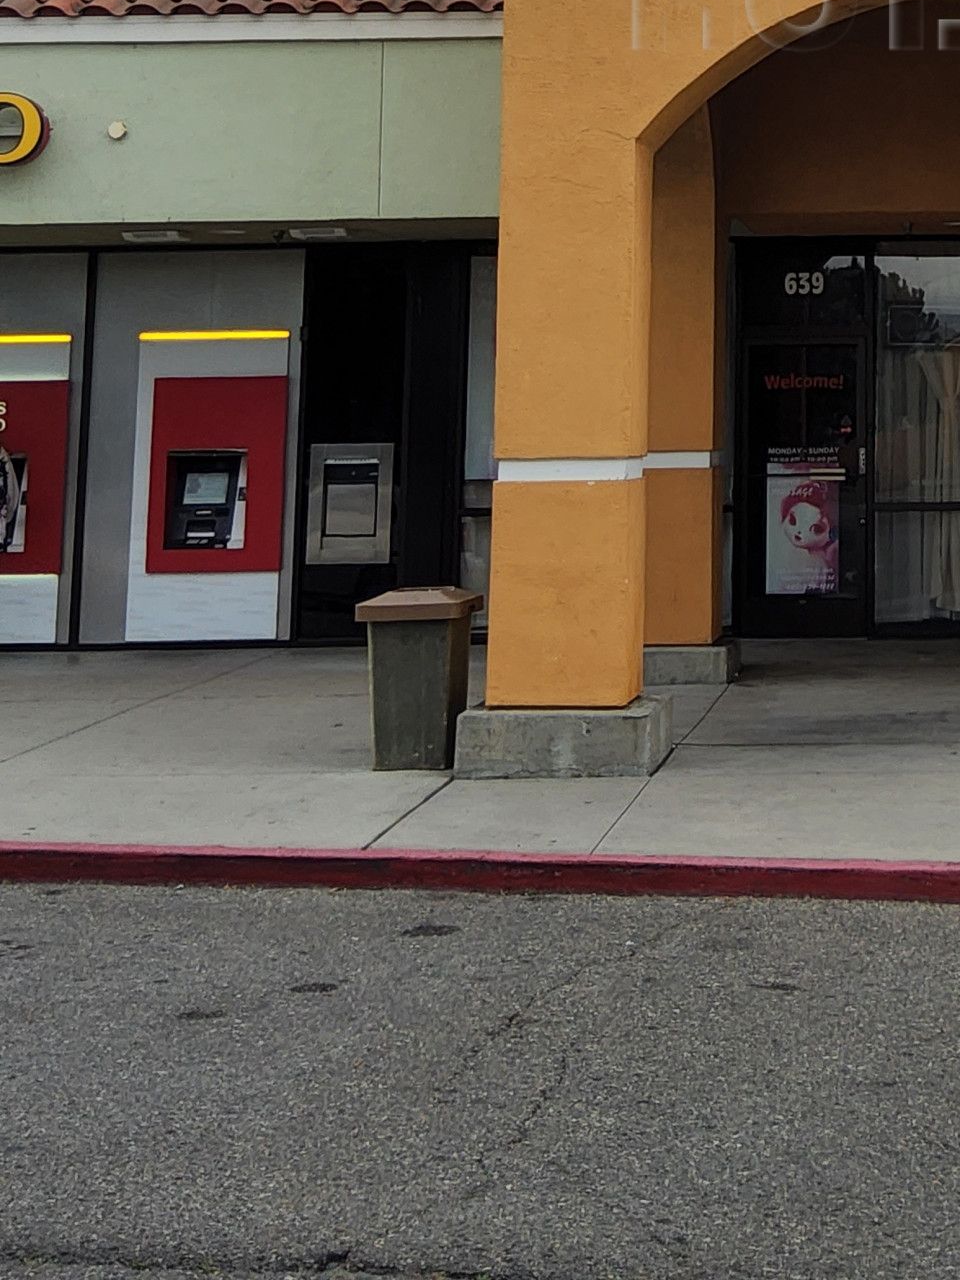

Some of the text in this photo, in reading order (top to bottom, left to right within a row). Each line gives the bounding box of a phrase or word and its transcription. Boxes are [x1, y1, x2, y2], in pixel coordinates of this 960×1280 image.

[784, 272, 825, 295] 639
[763, 373, 845, 390] Welcome!
[768, 447, 803, 455] MONDAY
